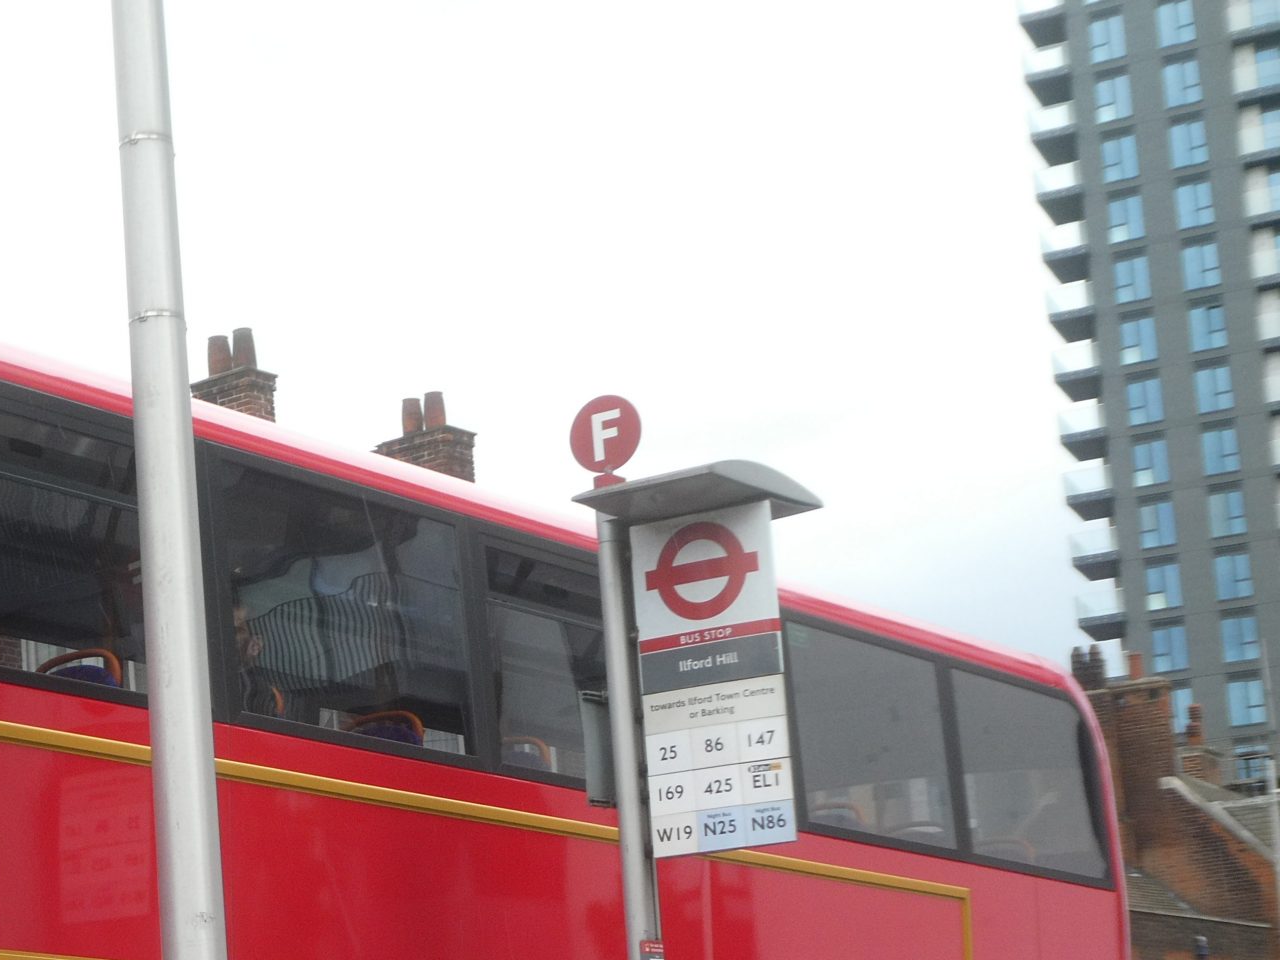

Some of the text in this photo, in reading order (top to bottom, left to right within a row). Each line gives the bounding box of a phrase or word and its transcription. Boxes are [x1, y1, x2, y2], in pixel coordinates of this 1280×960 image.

[591, 408, 621, 462] F
[680, 627, 732, 644] BUS STOP
[679, 652, 739, 672] Ilford Hill
[650, 686, 775, 712] towards Ilford Town Centre
[689, 705, 735, 719] or Barking
[659, 730, 776, 761] 25 86 147
[658, 773, 779, 801] 169 425 EL1
[656, 813, 787, 843] W19 N25 N86
